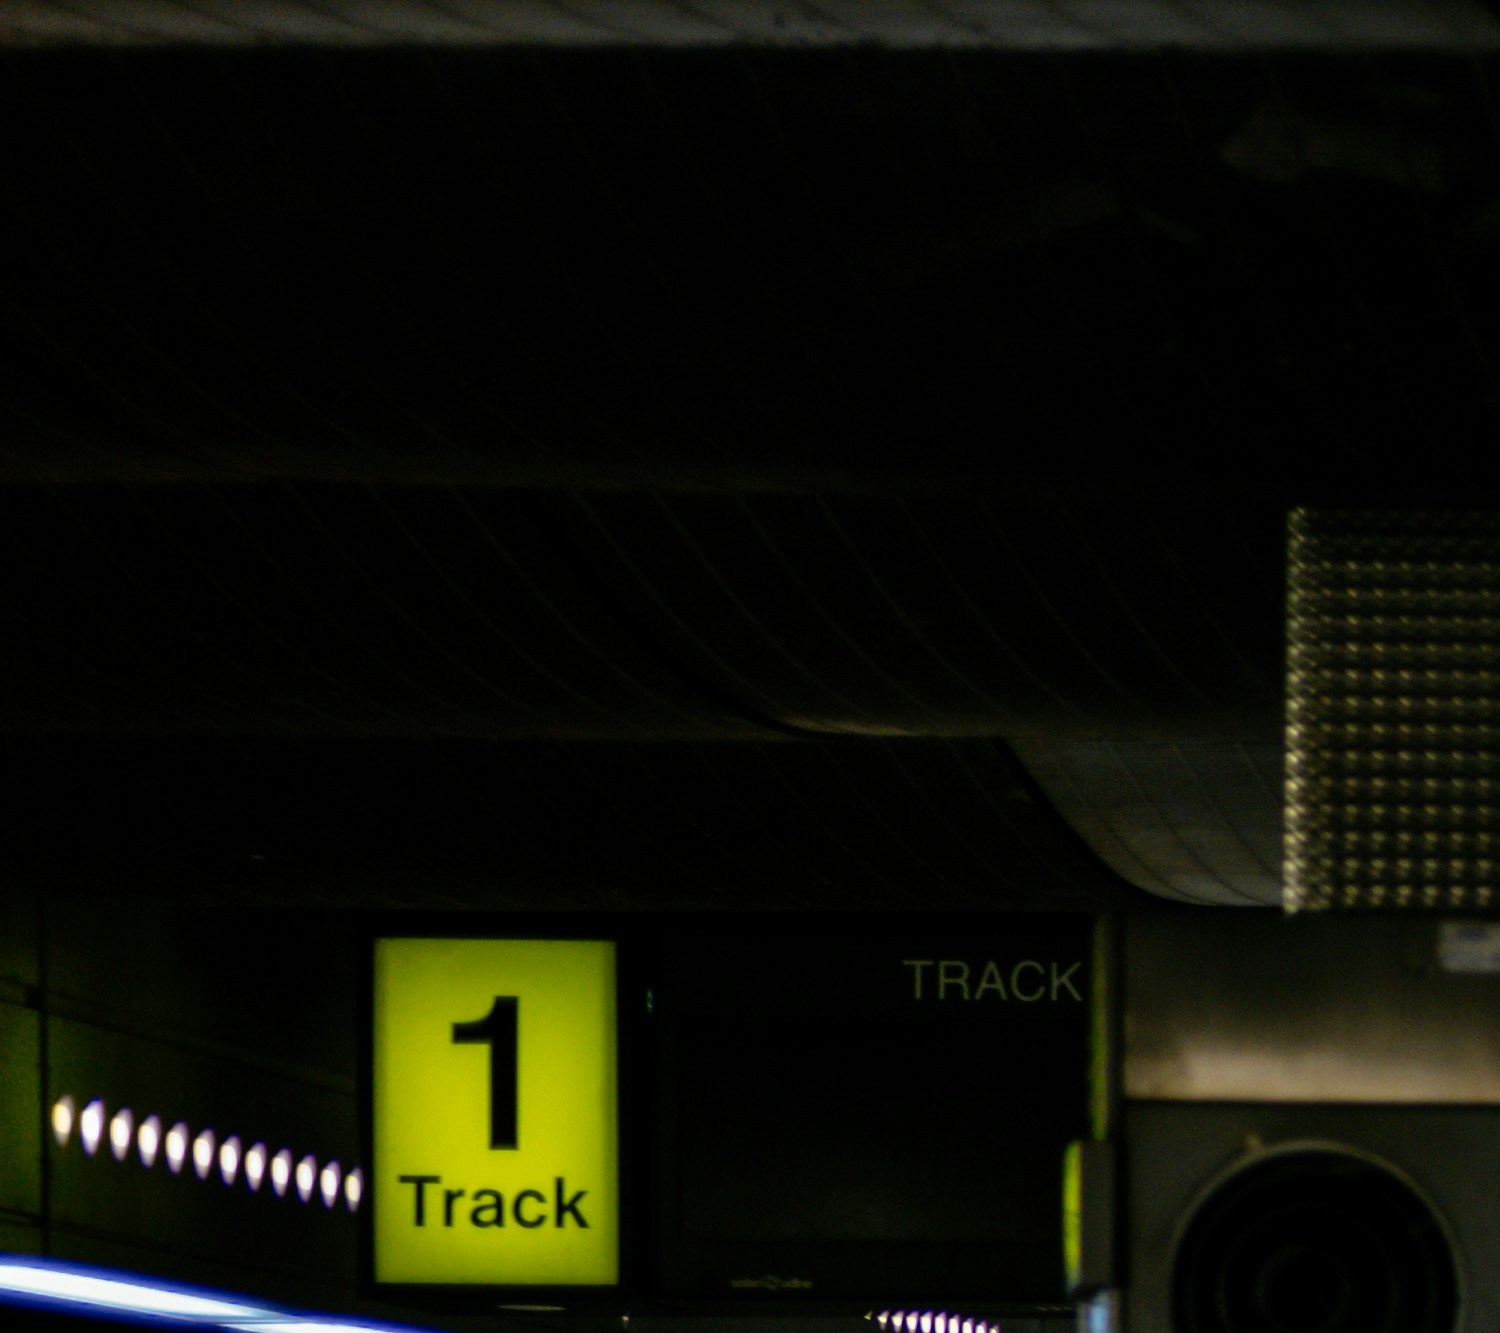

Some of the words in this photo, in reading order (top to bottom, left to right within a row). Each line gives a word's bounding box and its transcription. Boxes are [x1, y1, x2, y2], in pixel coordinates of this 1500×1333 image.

[903, 959, 1084, 1002] TRACK
[450, 995, 520, 1151] 1
[397, 1174, 592, 1229] Track
